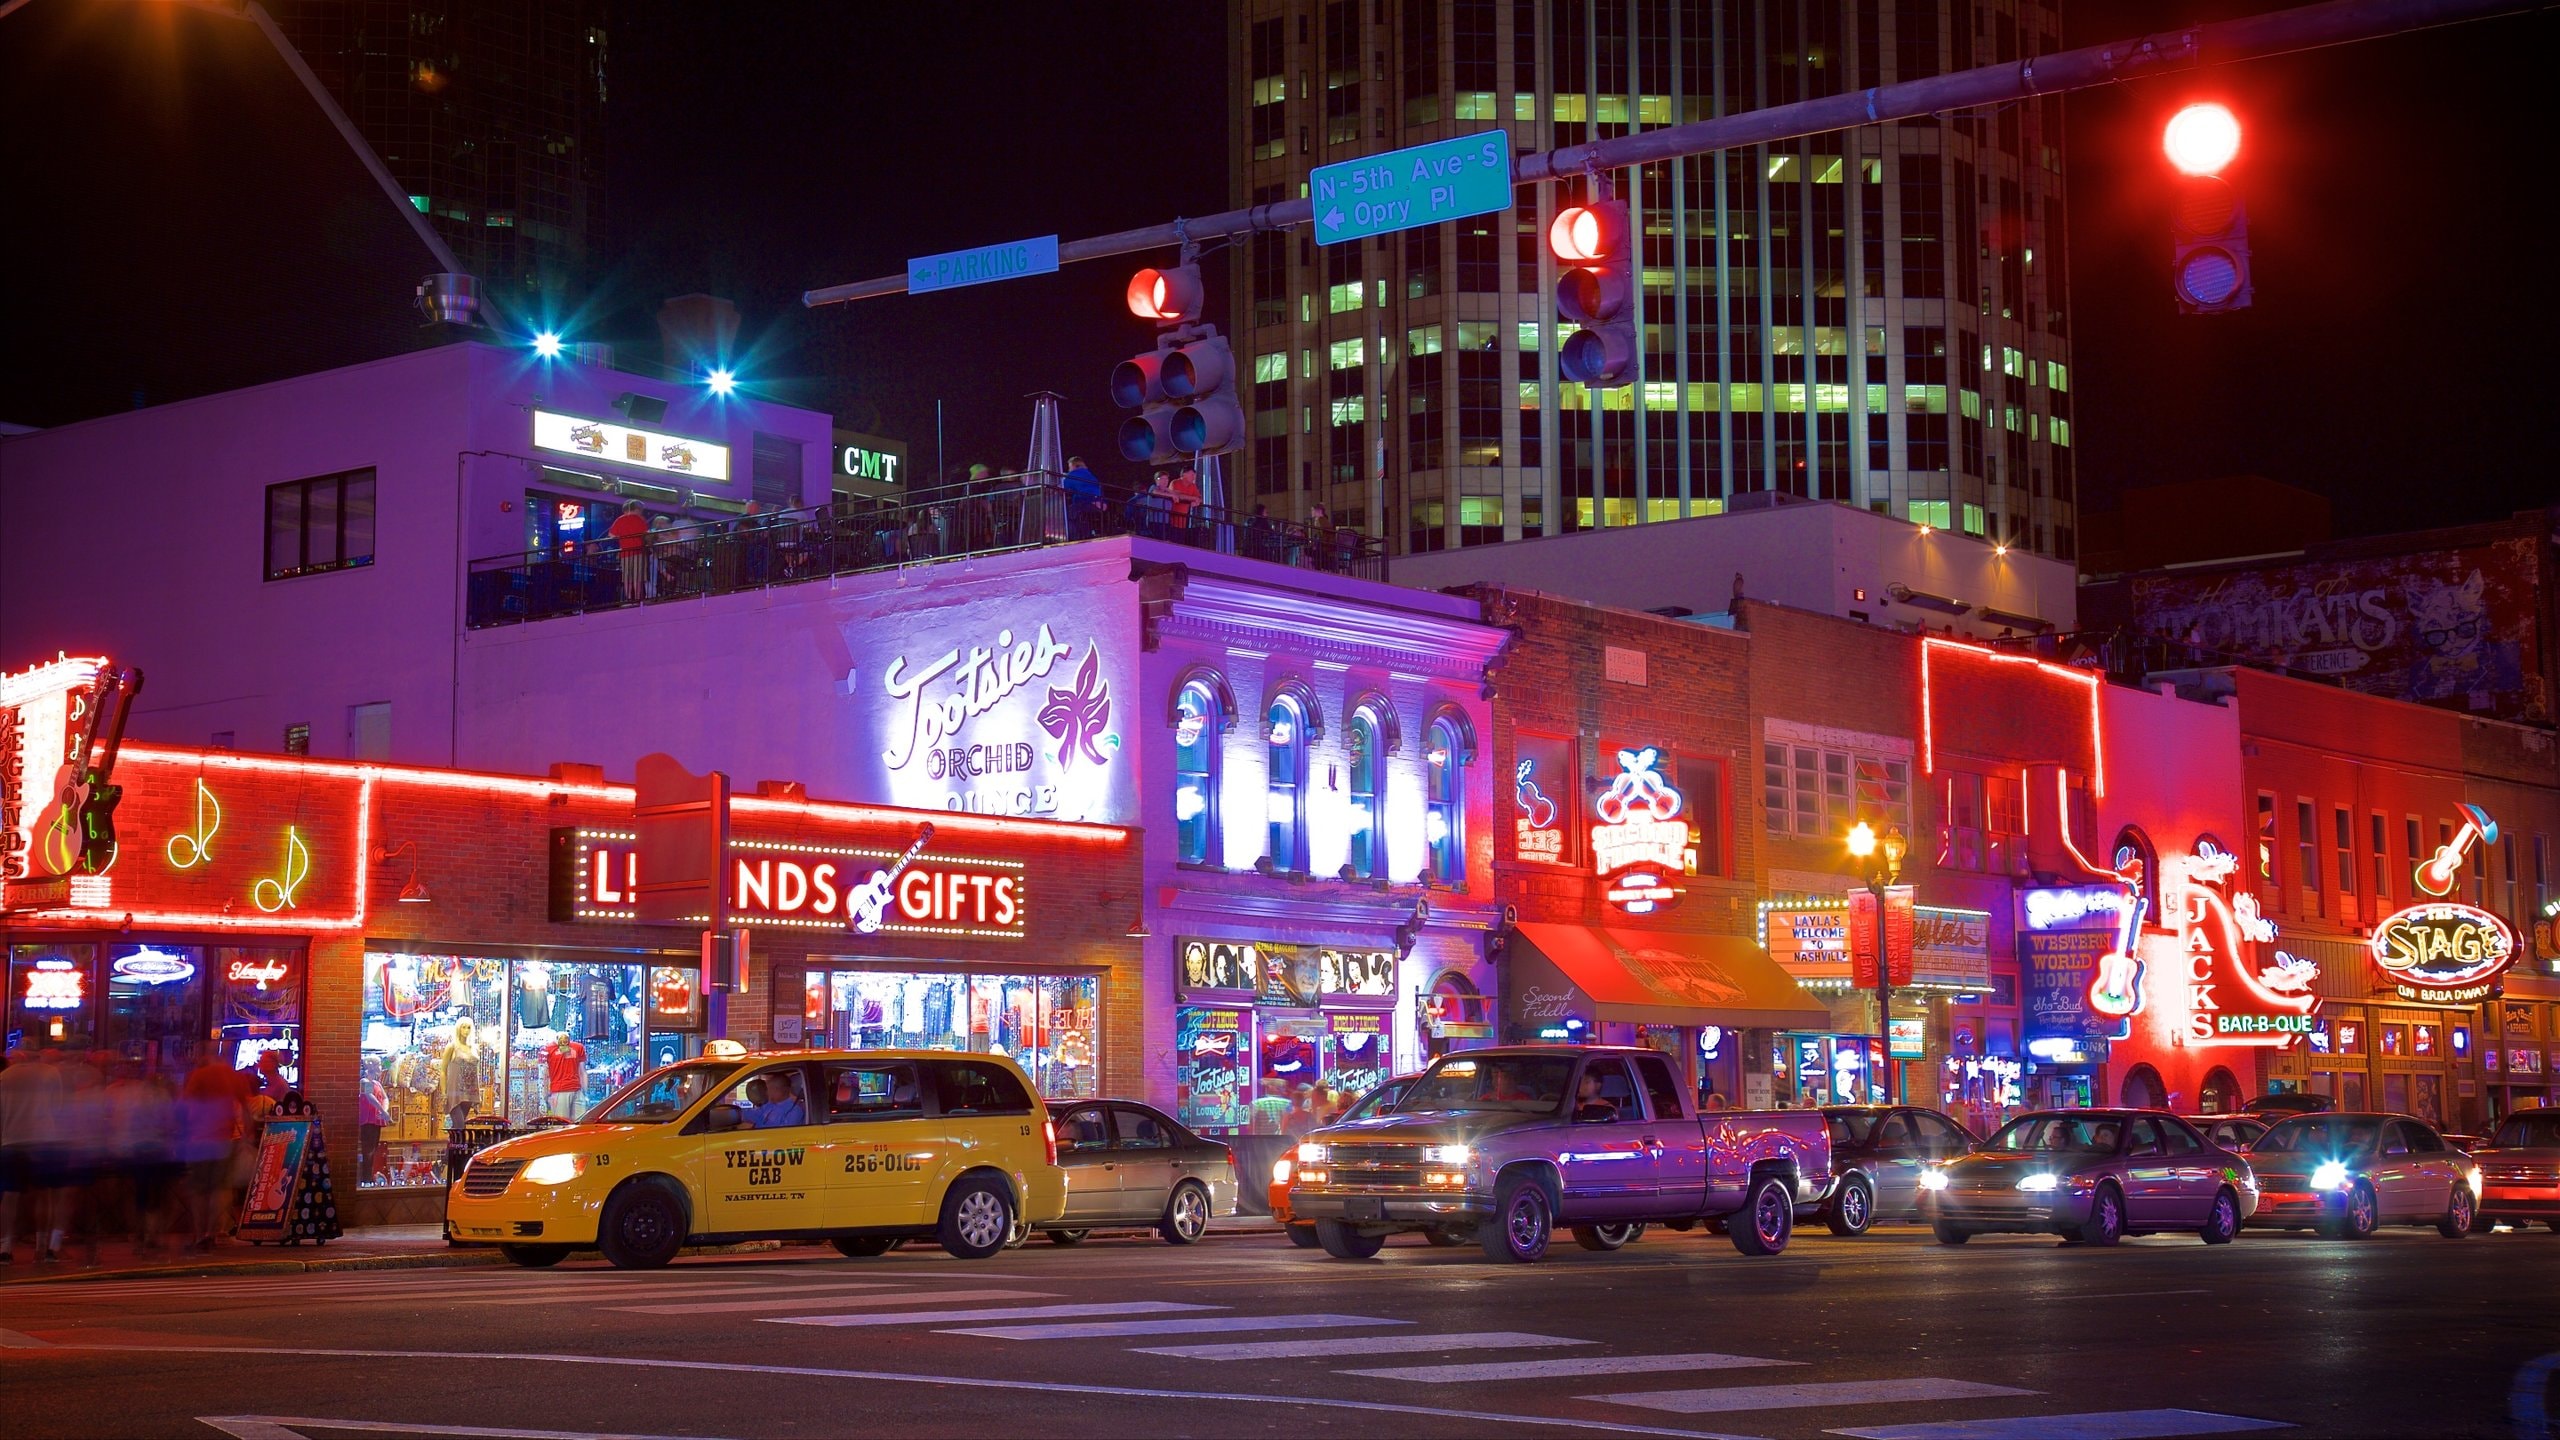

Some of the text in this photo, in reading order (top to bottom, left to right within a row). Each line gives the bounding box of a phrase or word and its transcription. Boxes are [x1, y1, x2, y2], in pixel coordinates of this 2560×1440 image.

[1320, 142, 1499, 202] N-5th Ave-S
[1354, 184, 1456, 228] Opry Pl
[936, 245, 1027, 284] PARKING
[844, 446, 897, 483] CMT
[882, 623, 1072, 770] Tootsies
[926, 742, 1034, 781] ORCHID
[3, 706, 26, 877] LEGENDS
[944, 784, 1059, 816] OUNGE
[900, 869, 1017, 925] GIFTS
[1794, 916, 1841, 926] LAYLA'S
[1792, 928, 1844, 939] WELCOME
[1887, 904, 1899, 978] NASHVILLE
[2031, 933, 2112, 951] WESTERN
[1812, 940, 1823, 948] TO
[2382, 917, 2507, 970] STAGE
[1794, 952, 1847, 962] NASHVILLE
[2032, 953, 2093, 970] WORLD
[2186, 896, 2220, 1040] JACKS
[2033, 972, 2082, 988] HOME
[1523, 986, 1575, 1003] Second
[2051, 988, 2060, 1001] of
[2398, 984, 2490, 1001] ON BROADWAY
[1523, 1002, 1576, 1019] Fiddle
[2034, 996, 2083, 1012] Sho-Bud
[1212, 1012, 1238, 1029] FAMOUS
[1333, 1016, 1379, 1032] WORLD FAMOUS
[2218, 1016, 2313, 1033] BAR-B-QUE
[1191, 1066, 1236, 1095] Tootsies
[1337, 1067, 1378, 1093] Tootsies
[1196, 1107, 1222, 1116] LOUNGE
[1020, 1125, 1031, 1137] 19
[596, 1154, 610, 1167] 19
[725, 1149, 805, 1168] YELLOW
[844, 1153, 921, 1172] 256-0101
[749, 1168, 781, 1185] CAB
[725, 1193, 786, 1201] NASHVILLE,
